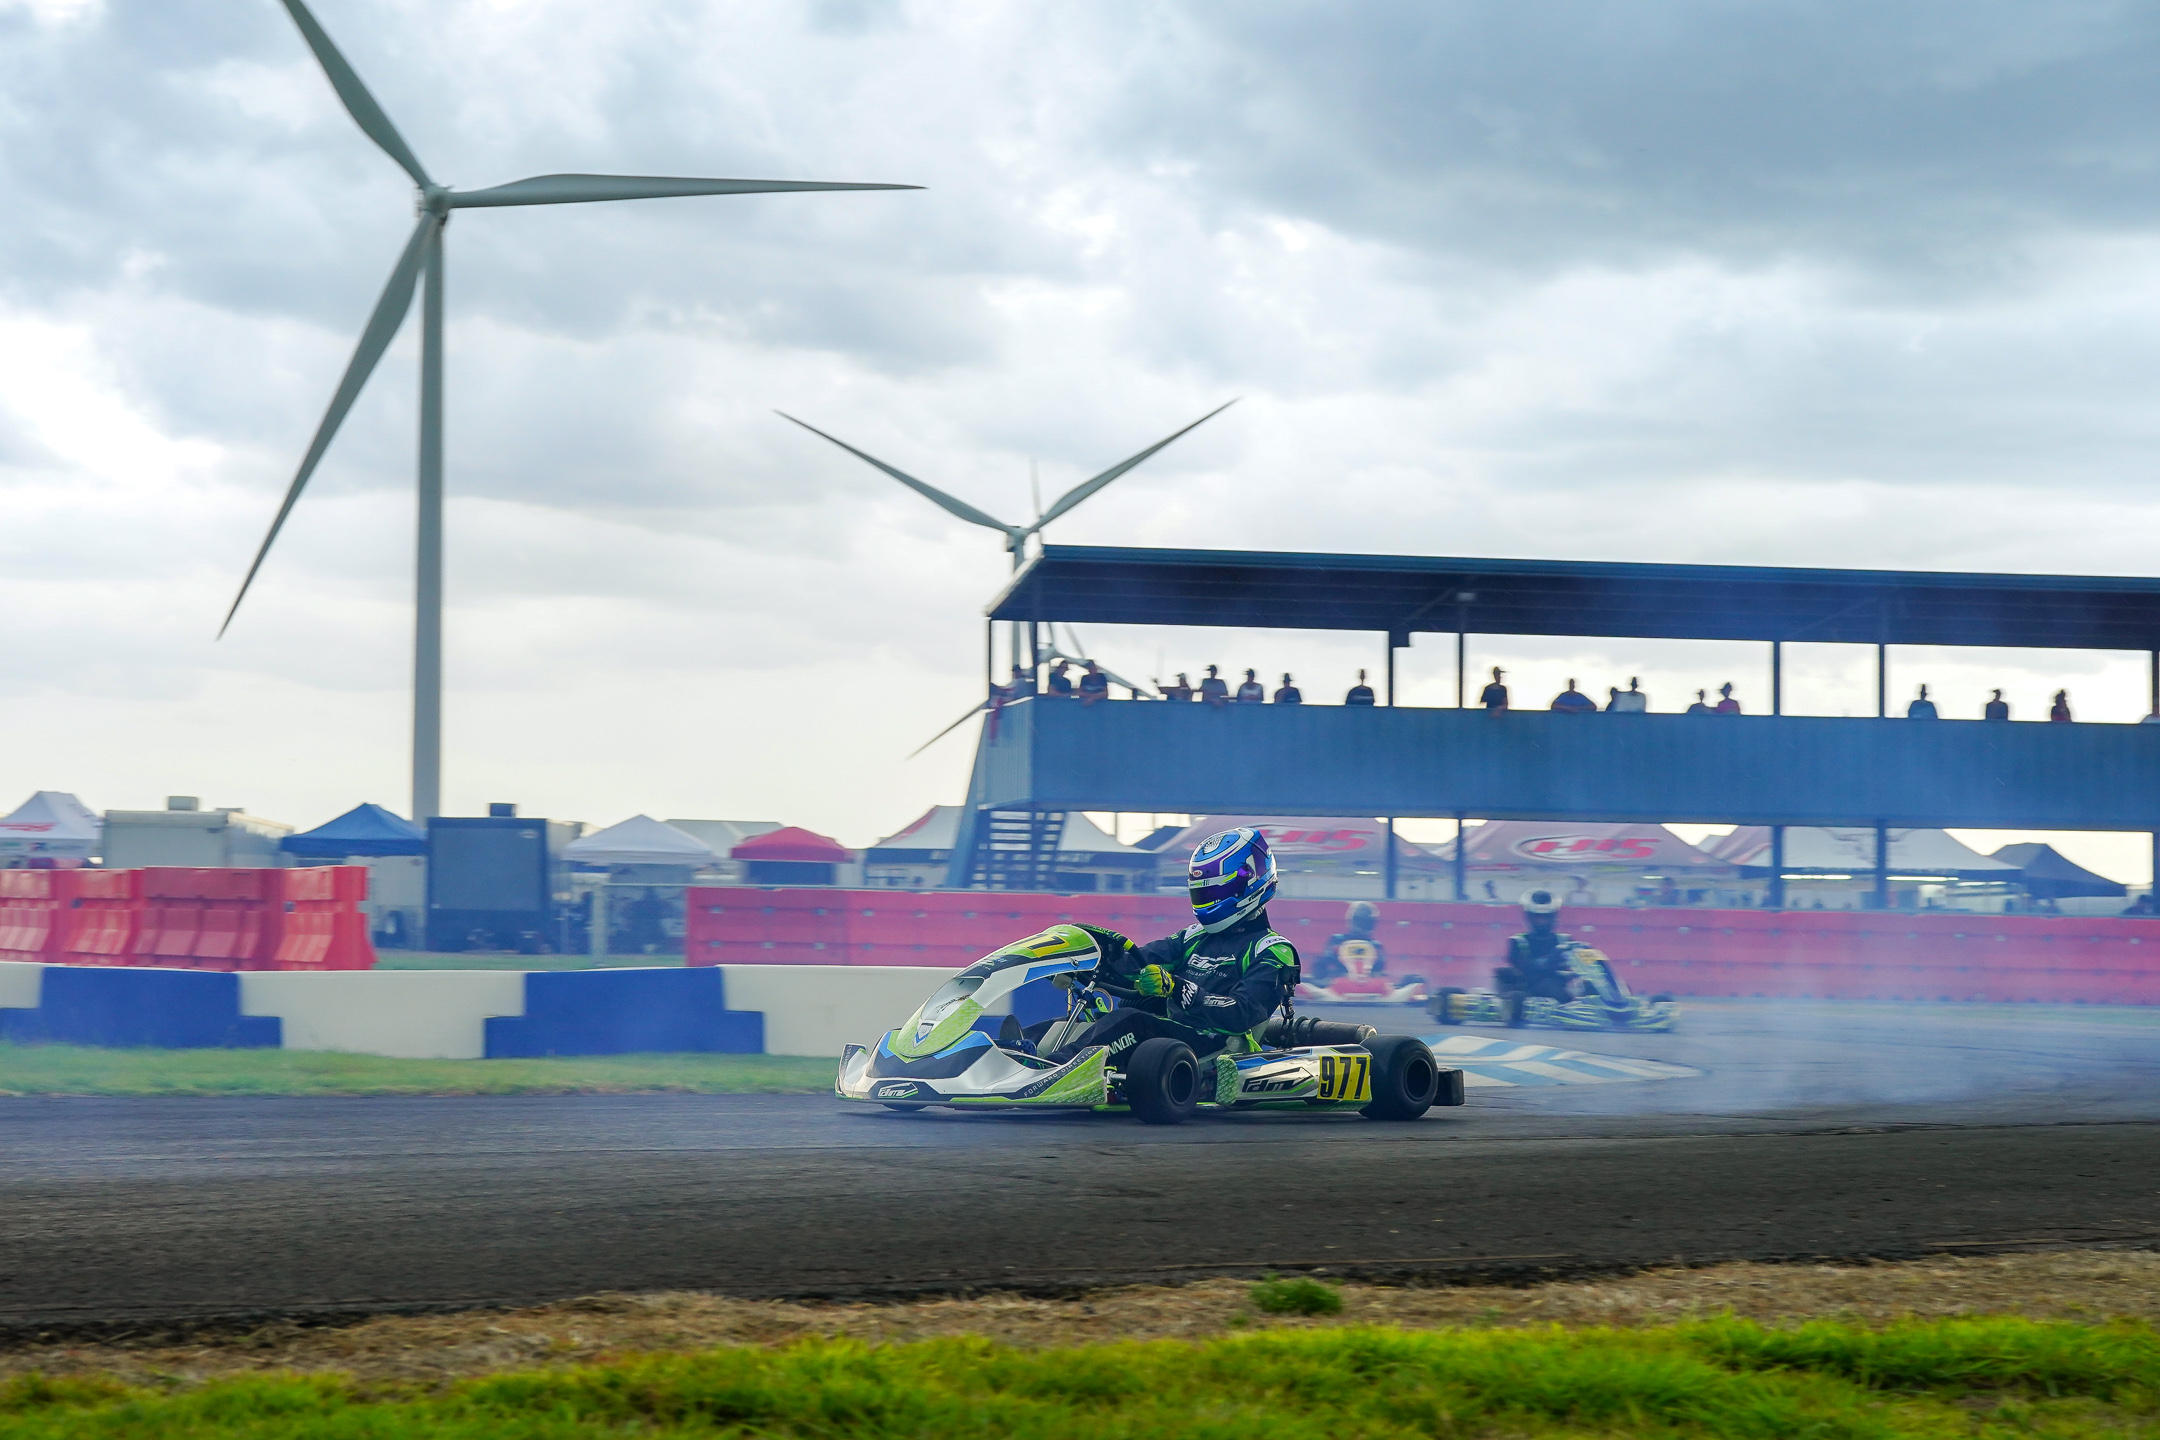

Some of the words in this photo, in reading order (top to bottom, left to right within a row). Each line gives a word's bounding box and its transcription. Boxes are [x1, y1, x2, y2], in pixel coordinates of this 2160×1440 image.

[1024, 1072, 1058, 1098] FORWARD
[1061, 1047, 1098, 1074] DIRECTION
[1319, 1056, 1367, 1099] 977
